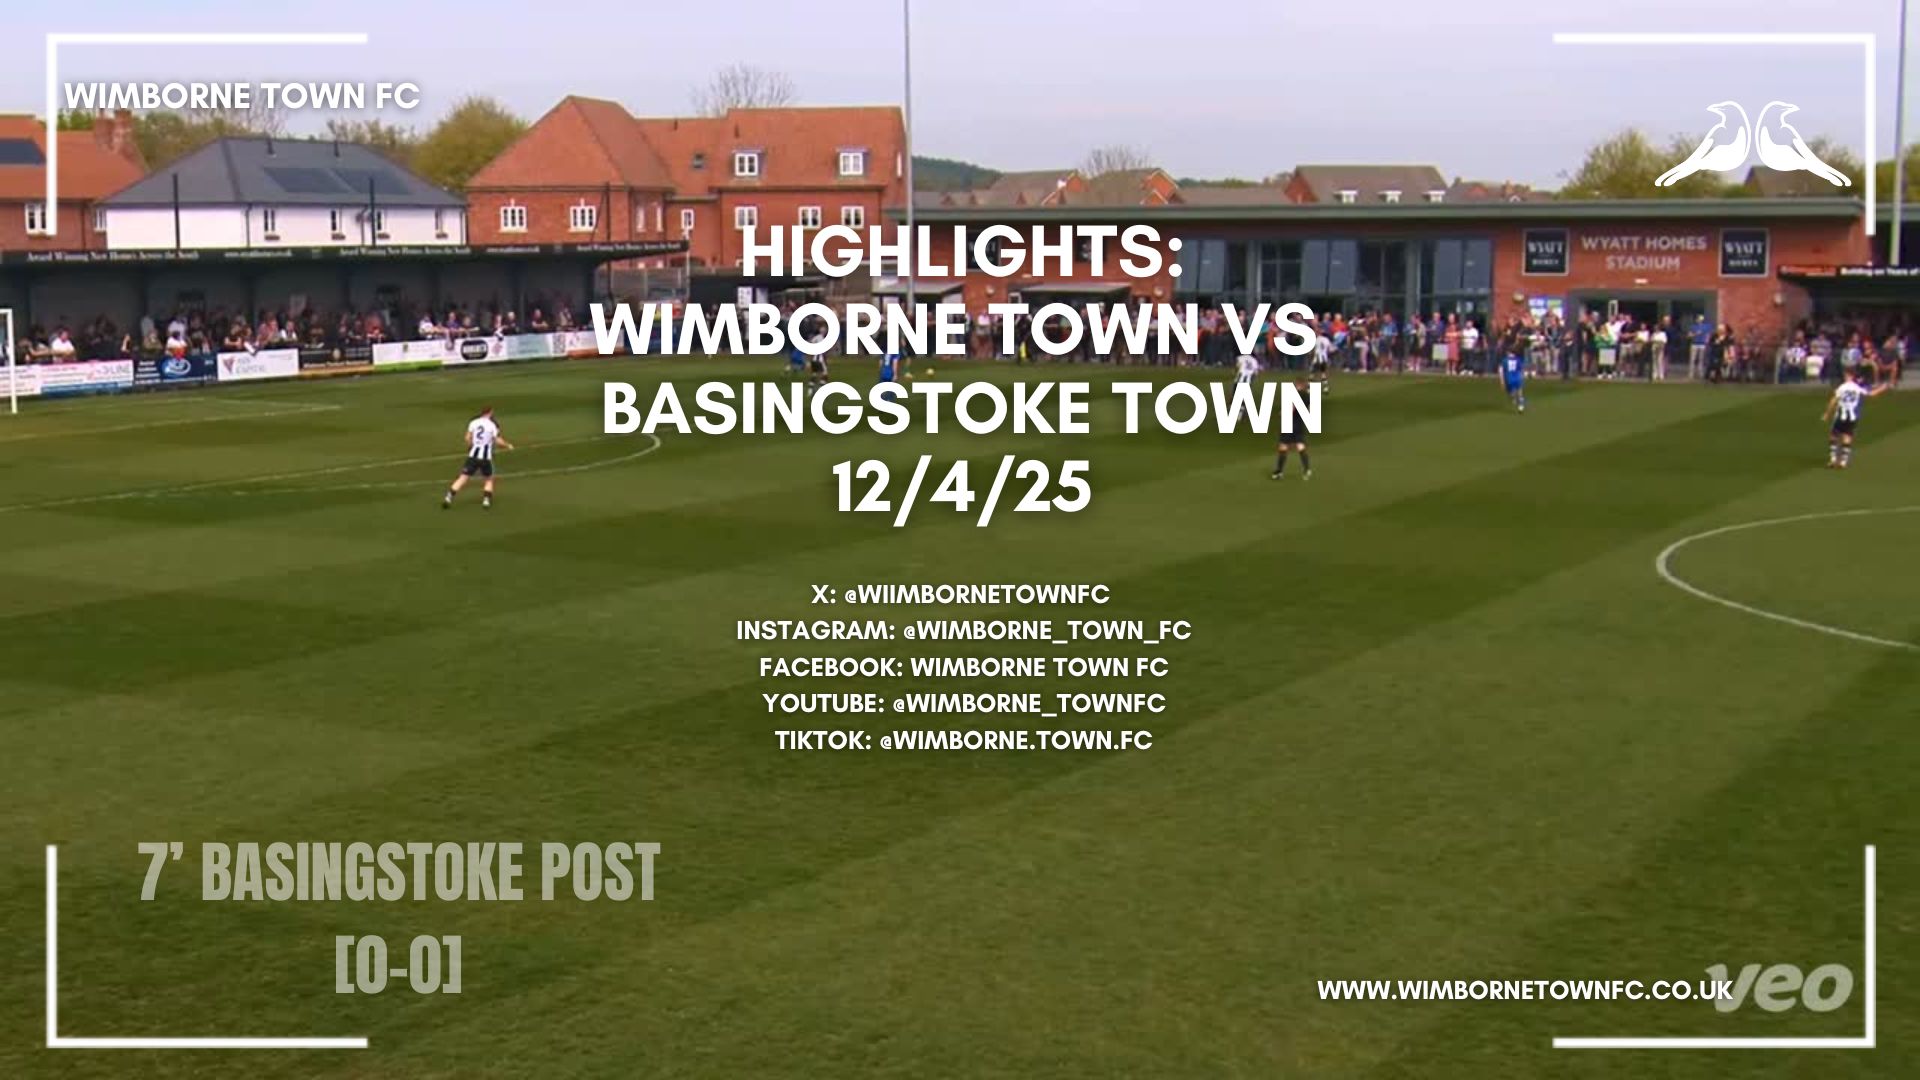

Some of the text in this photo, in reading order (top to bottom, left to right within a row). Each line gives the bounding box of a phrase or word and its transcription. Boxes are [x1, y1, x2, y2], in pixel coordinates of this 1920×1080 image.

[1581, 236, 1707, 250] WYATT HOMES
[1606, 257, 1680, 270] STADIUM
[476, 425, 485, 440] 2
